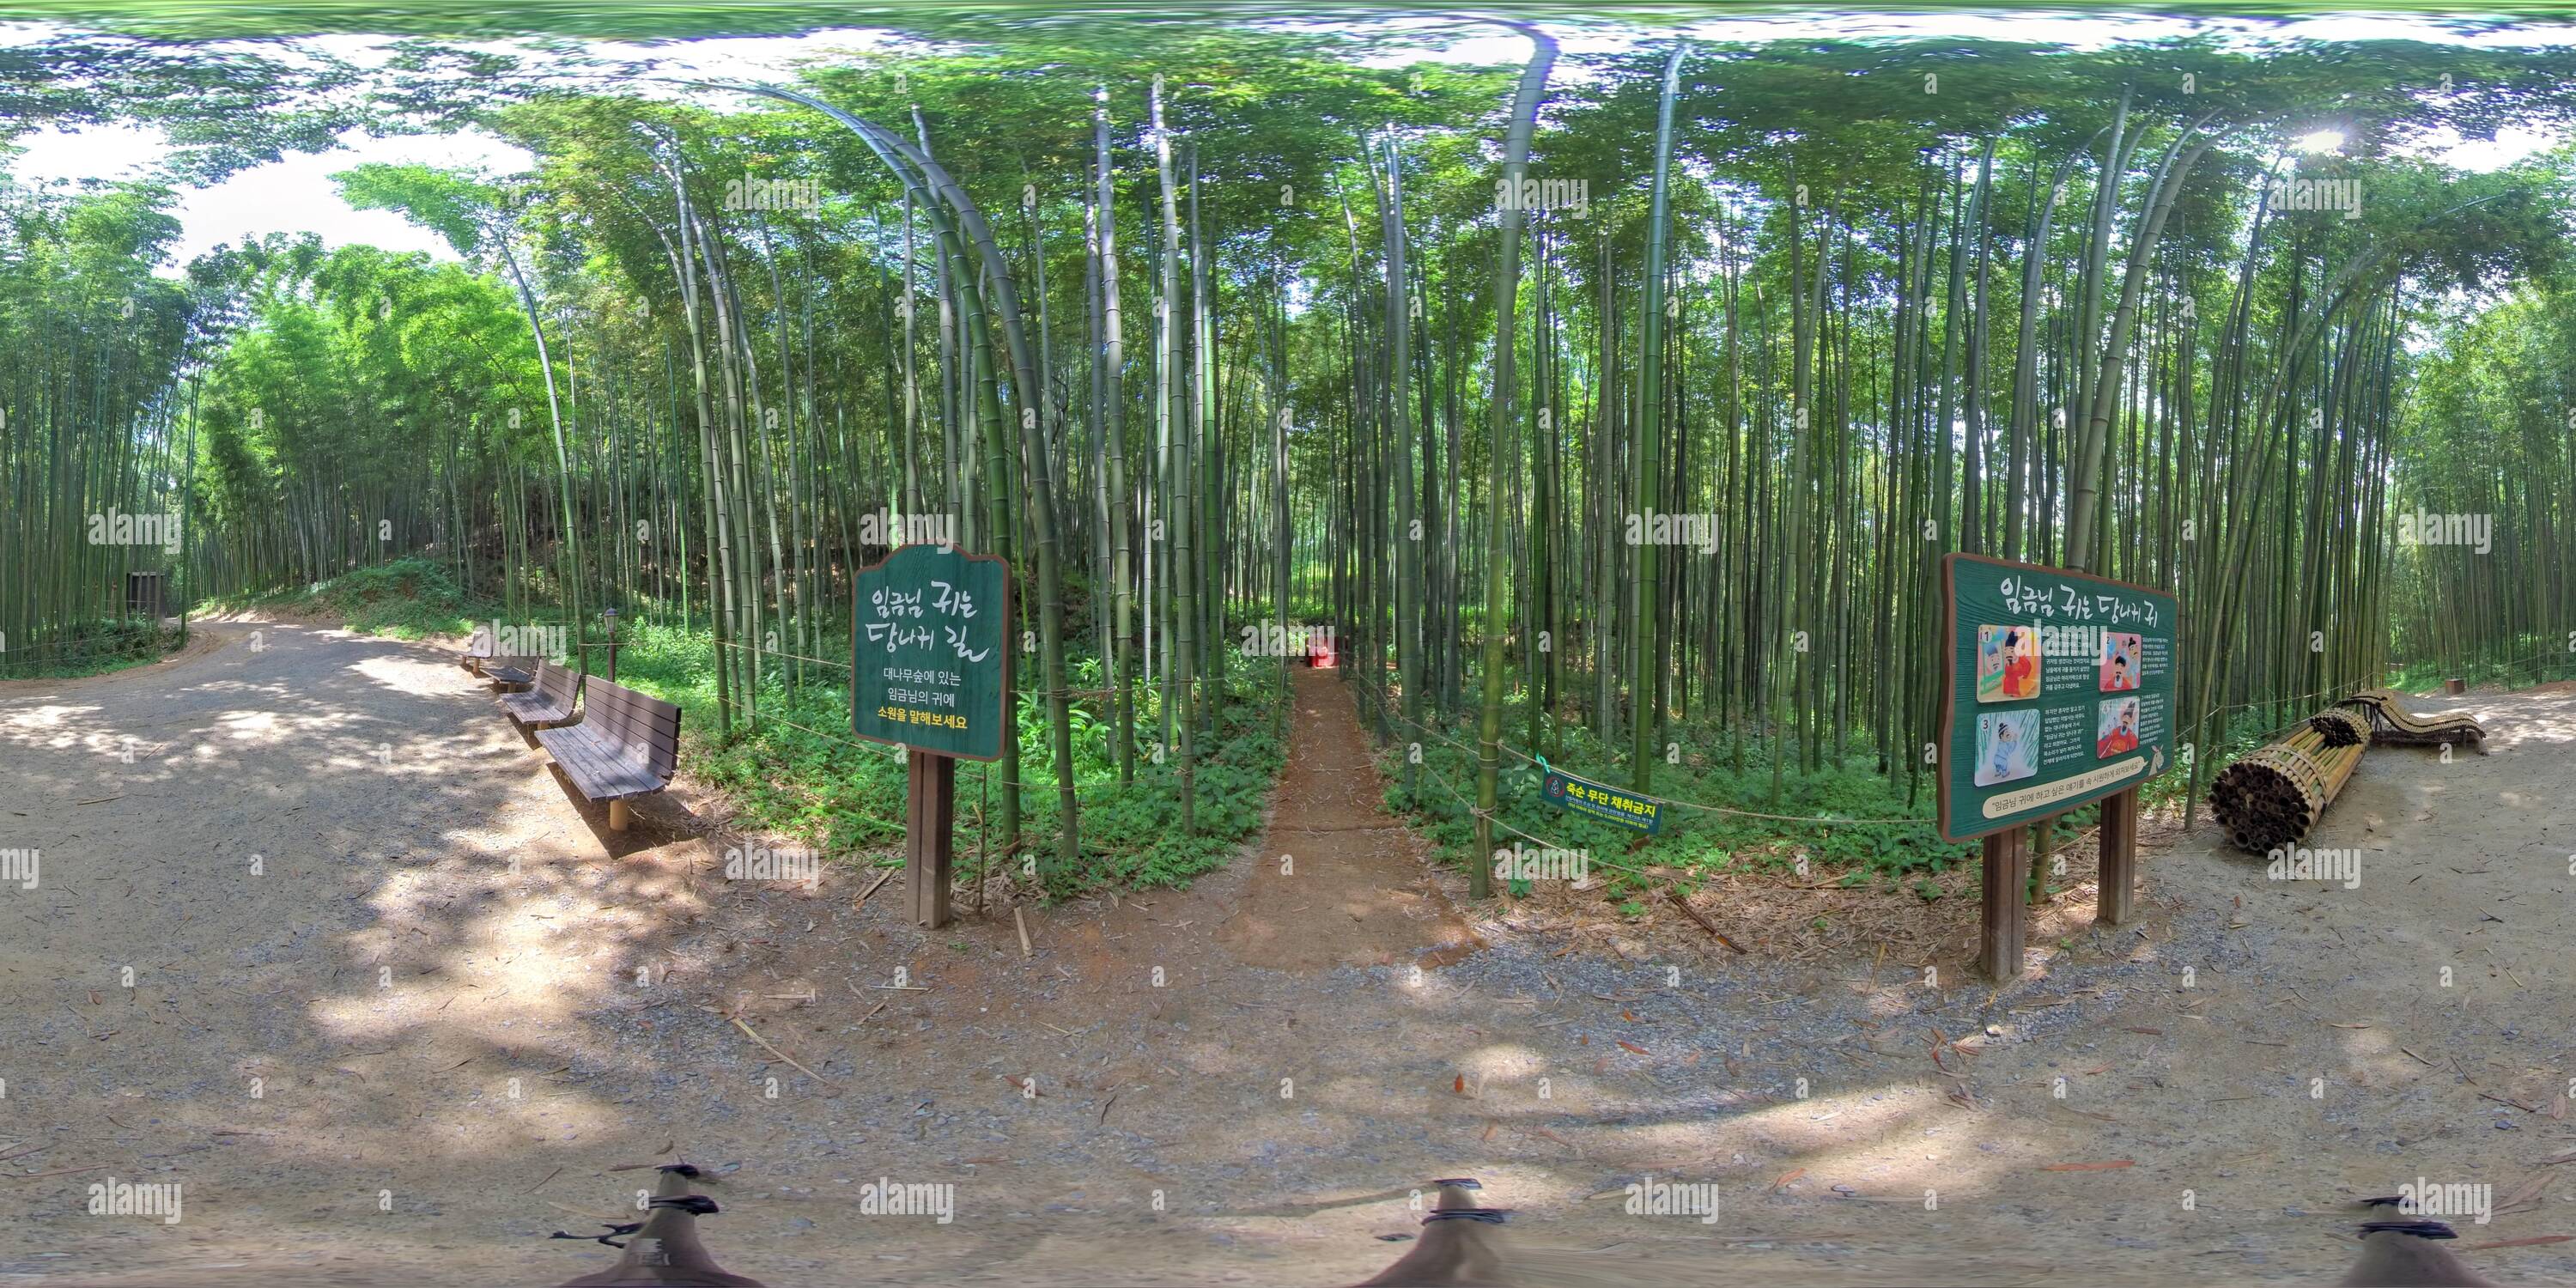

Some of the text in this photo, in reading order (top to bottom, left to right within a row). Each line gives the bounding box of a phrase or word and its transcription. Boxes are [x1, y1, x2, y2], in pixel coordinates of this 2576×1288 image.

[872, 580, 977, 619] 임금님 귀는
[2001, 575, 2158, 628] 임금님 귀는 당나귀 귀
[866, 623, 989, 663] 당나귀 길
[883, 667, 962, 687] 대나무숲에 있는
[888, 687, 955, 708] 임금님의 귀에
[878, 707, 967, 730] 소원을 말해보세요
[1984, 720, 1989, 730] 3
[1566, 782, 1656, 817] 죽순 무단 채취금지
[2019, 794, 2035, 805] 귀에
[2036, 790, 2050, 800] 하고
[2051, 787, 2064, 797] 싶은
[2093, 771, 2114, 783] 시원하게
